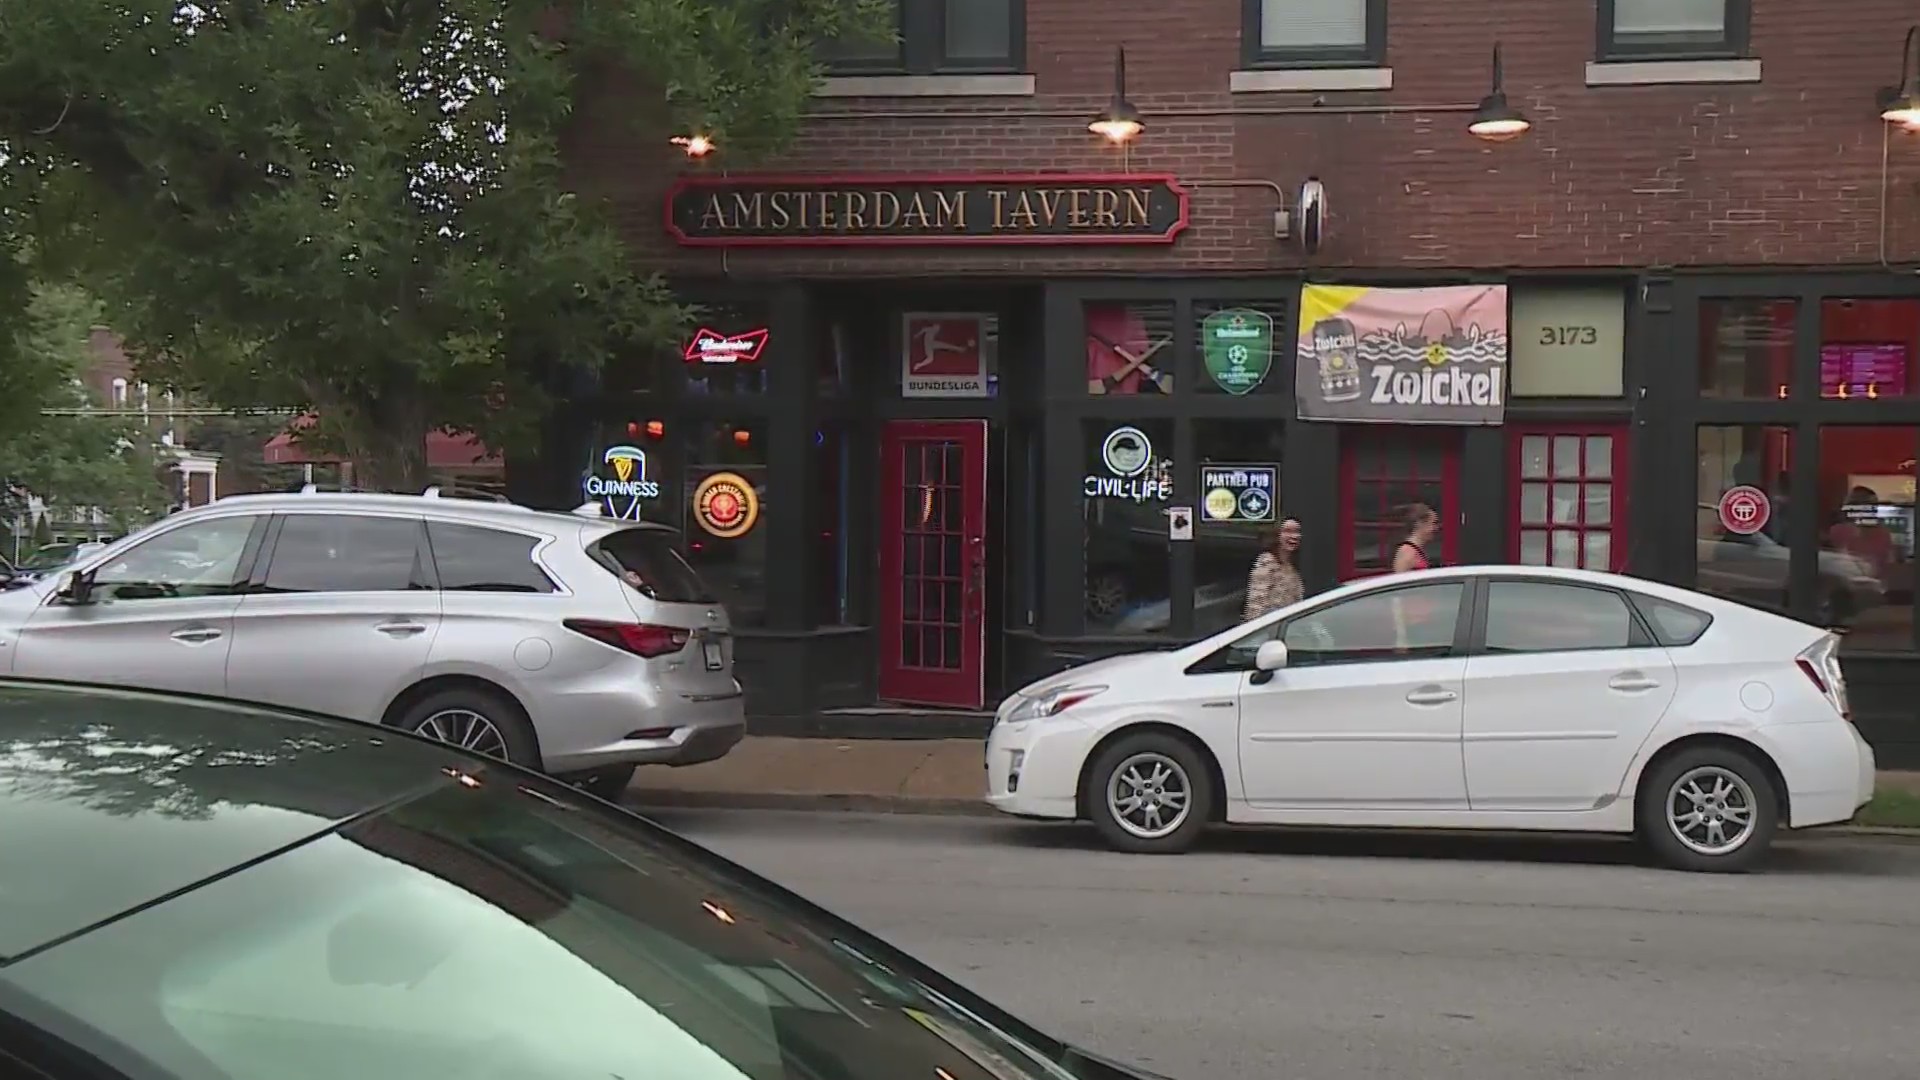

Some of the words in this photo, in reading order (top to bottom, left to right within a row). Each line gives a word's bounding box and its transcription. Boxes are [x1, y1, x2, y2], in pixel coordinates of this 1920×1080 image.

[700, 191, 967, 230] AMSTERDAM
[987, 189, 1154, 229] TAVERN
[1539, 326, 1597, 345] 3173
[909, 381, 979, 391] BUNDESLIGA
[1370, 365, 1501, 406] Zwickel
[587, 476, 659, 497] GUINNESS
[1207, 472, 1248, 487] PARTNER
[1250, 473, 1269, 488] PUB
